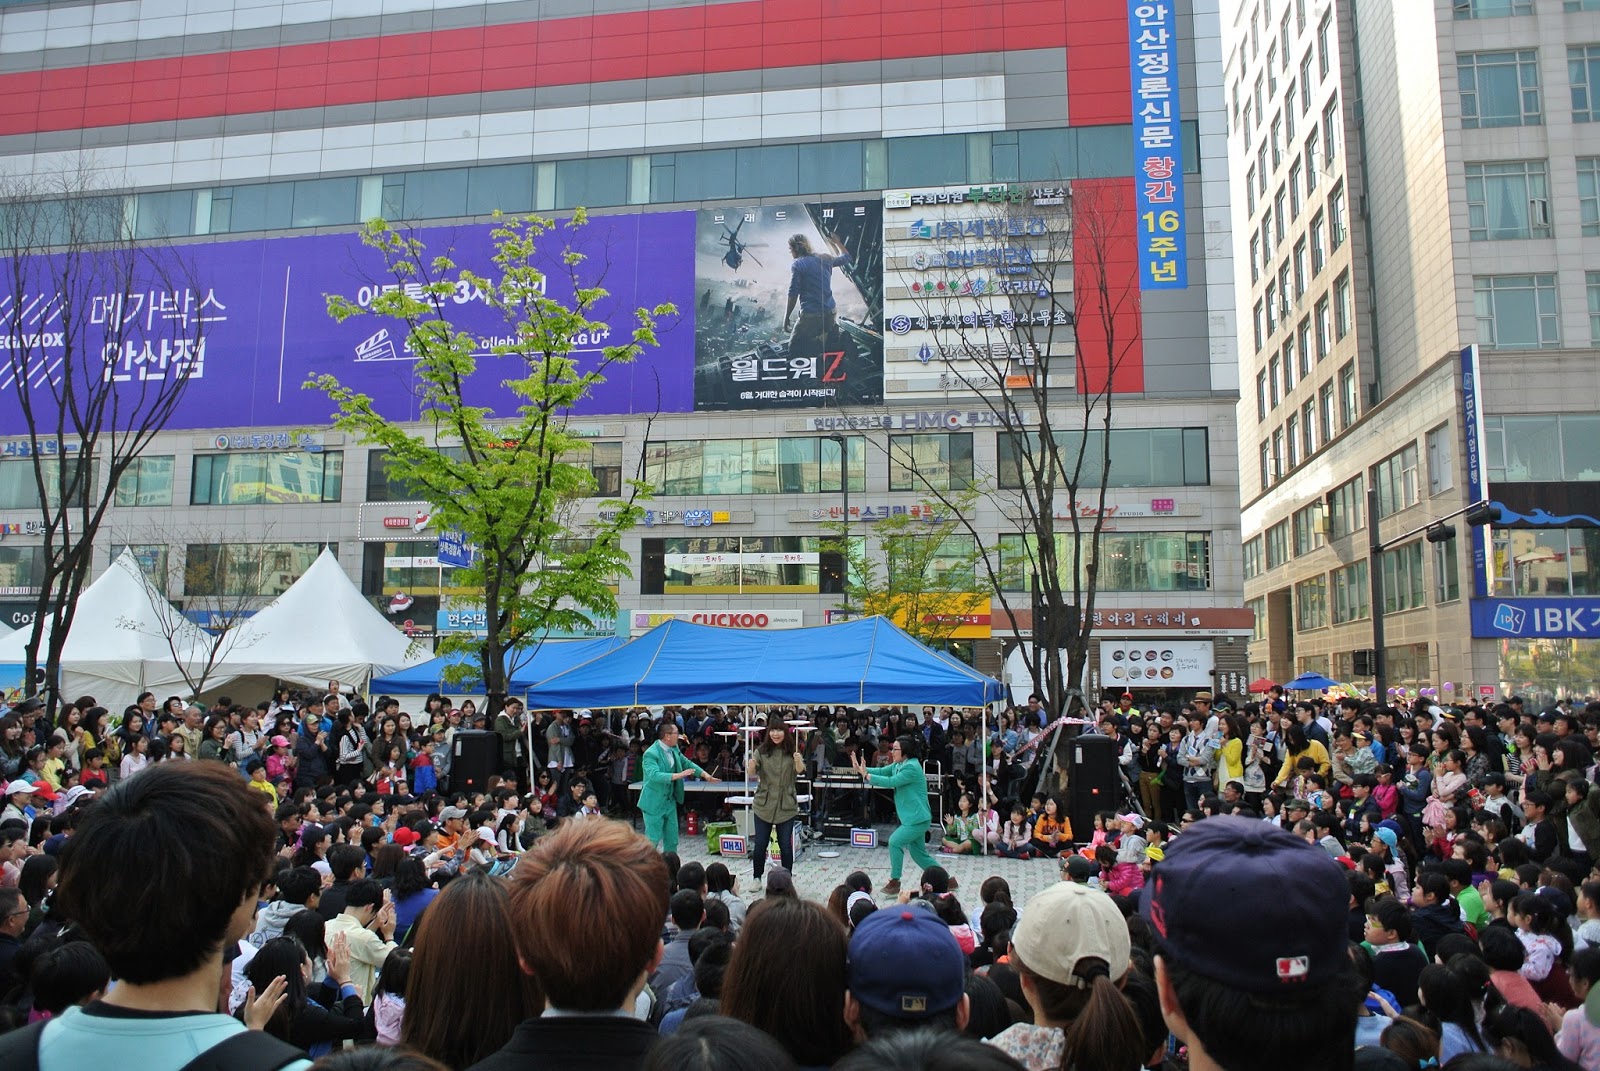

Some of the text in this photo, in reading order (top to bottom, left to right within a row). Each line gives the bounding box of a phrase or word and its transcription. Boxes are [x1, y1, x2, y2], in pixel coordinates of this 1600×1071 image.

[1134, 4, 1180, 282] 안산정론신문 창간 16주년
[912, 191, 963, 205] 국회의원
[1031, 187, 1066, 199] 사무소
[714, 206, 866, 225] 브래드 피트
[90, 288, 228, 332] 메가박스
[1019, 308, 1067, 327] 사무소
[570, 333, 588, 345] LG
[101, 336, 207, 383] 안산점
[755, 390, 778, 400] 거대한
[779, 389, 802, 399] 습격이
[803, 388, 836, 398] 시작된다!
[1465, 394, 1475, 421] IBK
[814, 415, 893, 431] 현대자동차그룹
[901, 410, 962, 431] HMC
[230, 433, 316, 449] (주)동양컨스
[659, 510, 684, 523] 법무사
[861, 505, 907, 521] 스크린
[910, 505, 933, 517] 골프
[447, 612, 487, 628] 현수막
[691, 613, 770, 628] CUCKOO
[1140, 611, 1186, 627] 수제비
[1534, 607, 1587, 632] IBK
[722, 840, 744, 852] 매직
